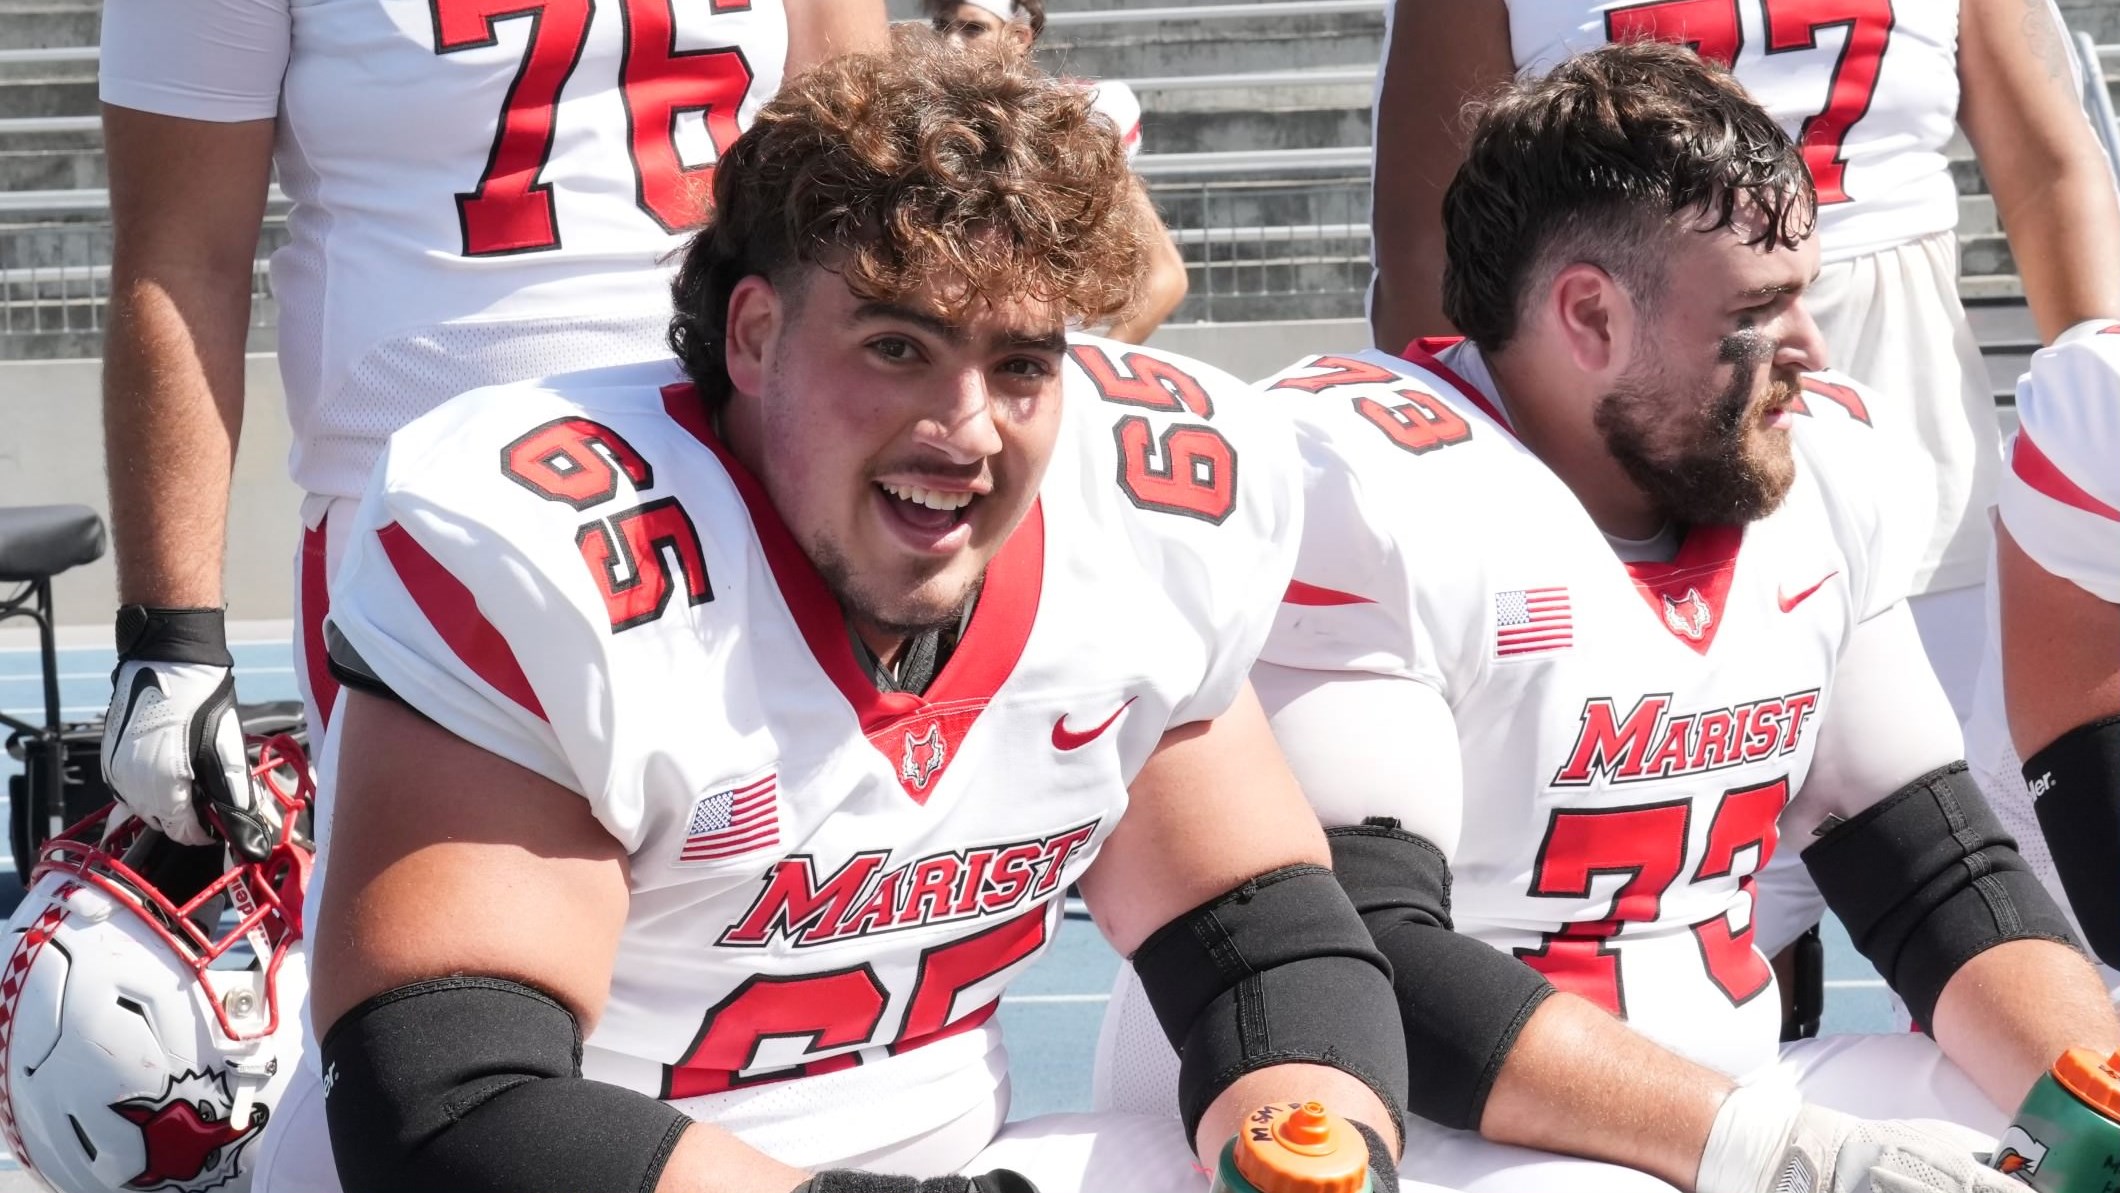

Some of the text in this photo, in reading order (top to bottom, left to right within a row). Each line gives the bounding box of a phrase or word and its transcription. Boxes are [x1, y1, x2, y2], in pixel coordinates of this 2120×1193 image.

[431, 0, 755, 258] 76
[1066, 343, 1239, 527] 65
[1264, 355, 1474, 457] 73
[500, 415, 715, 635] 65
[1512, 773, 1791, 1022] 73
